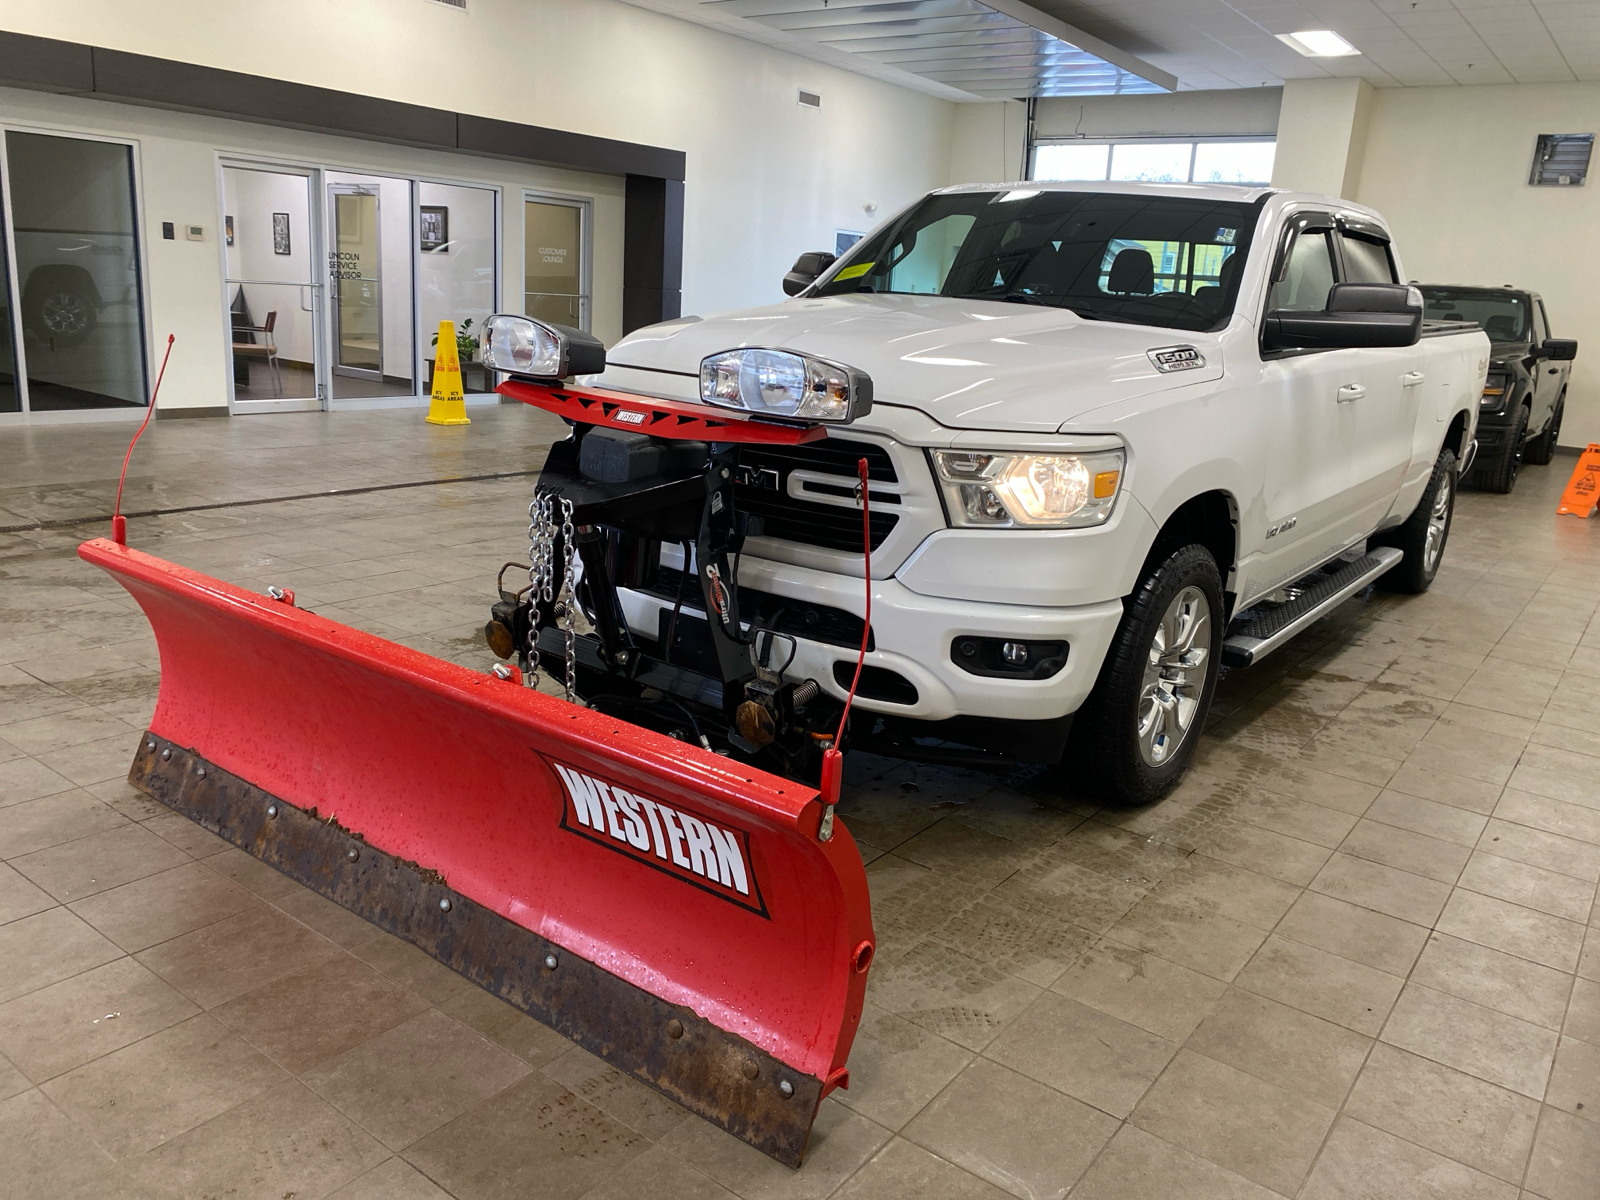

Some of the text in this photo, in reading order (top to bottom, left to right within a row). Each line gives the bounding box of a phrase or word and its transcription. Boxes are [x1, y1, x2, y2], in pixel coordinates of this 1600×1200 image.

[538, 247, 567, 256] CUSTOMER
[328, 252, 360, 261] LINCOLN
[541, 255, 564, 263] LOUNGE
[328, 260, 357, 270] SERVICE
[329, 270, 362, 279] ADVISOR
[1157, 350, 1196, 363] 1500
[616, 410, 646, 424] WESTERN
[553, 762, 749, 895] WESTERN
